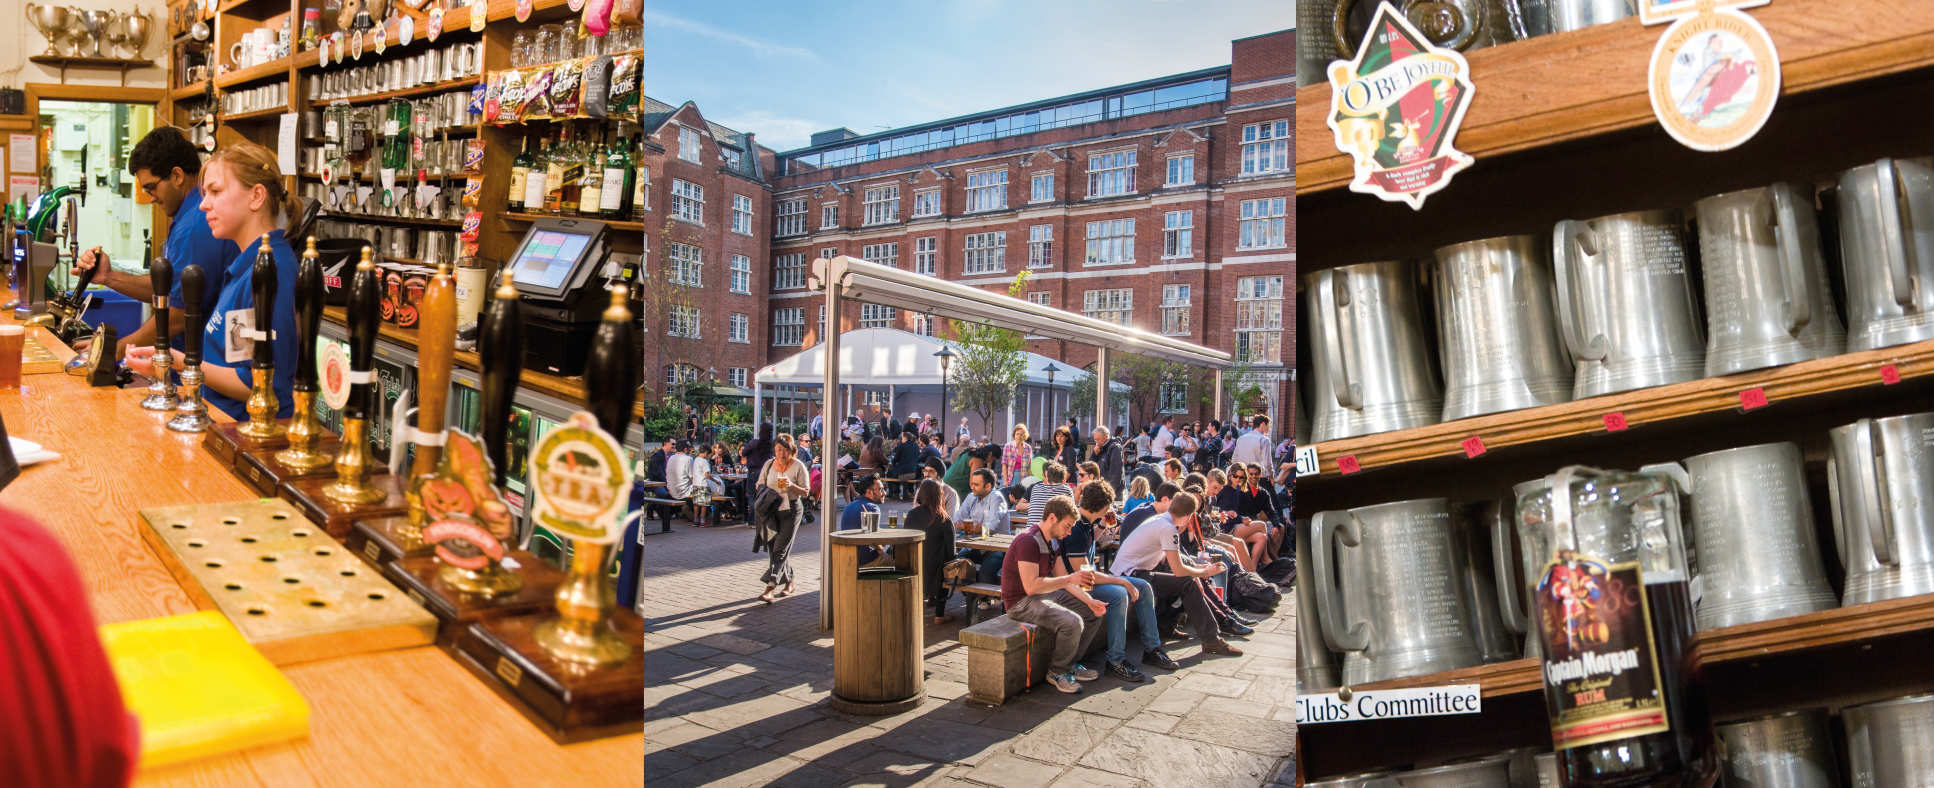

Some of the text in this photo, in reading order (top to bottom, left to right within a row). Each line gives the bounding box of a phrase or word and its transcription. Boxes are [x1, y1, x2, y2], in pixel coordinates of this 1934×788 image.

[1582, 649, 1639, 681] Morgan
[1357, 691, 1478, 719] Committee
[1575, 688, 1607, 707] RUM
